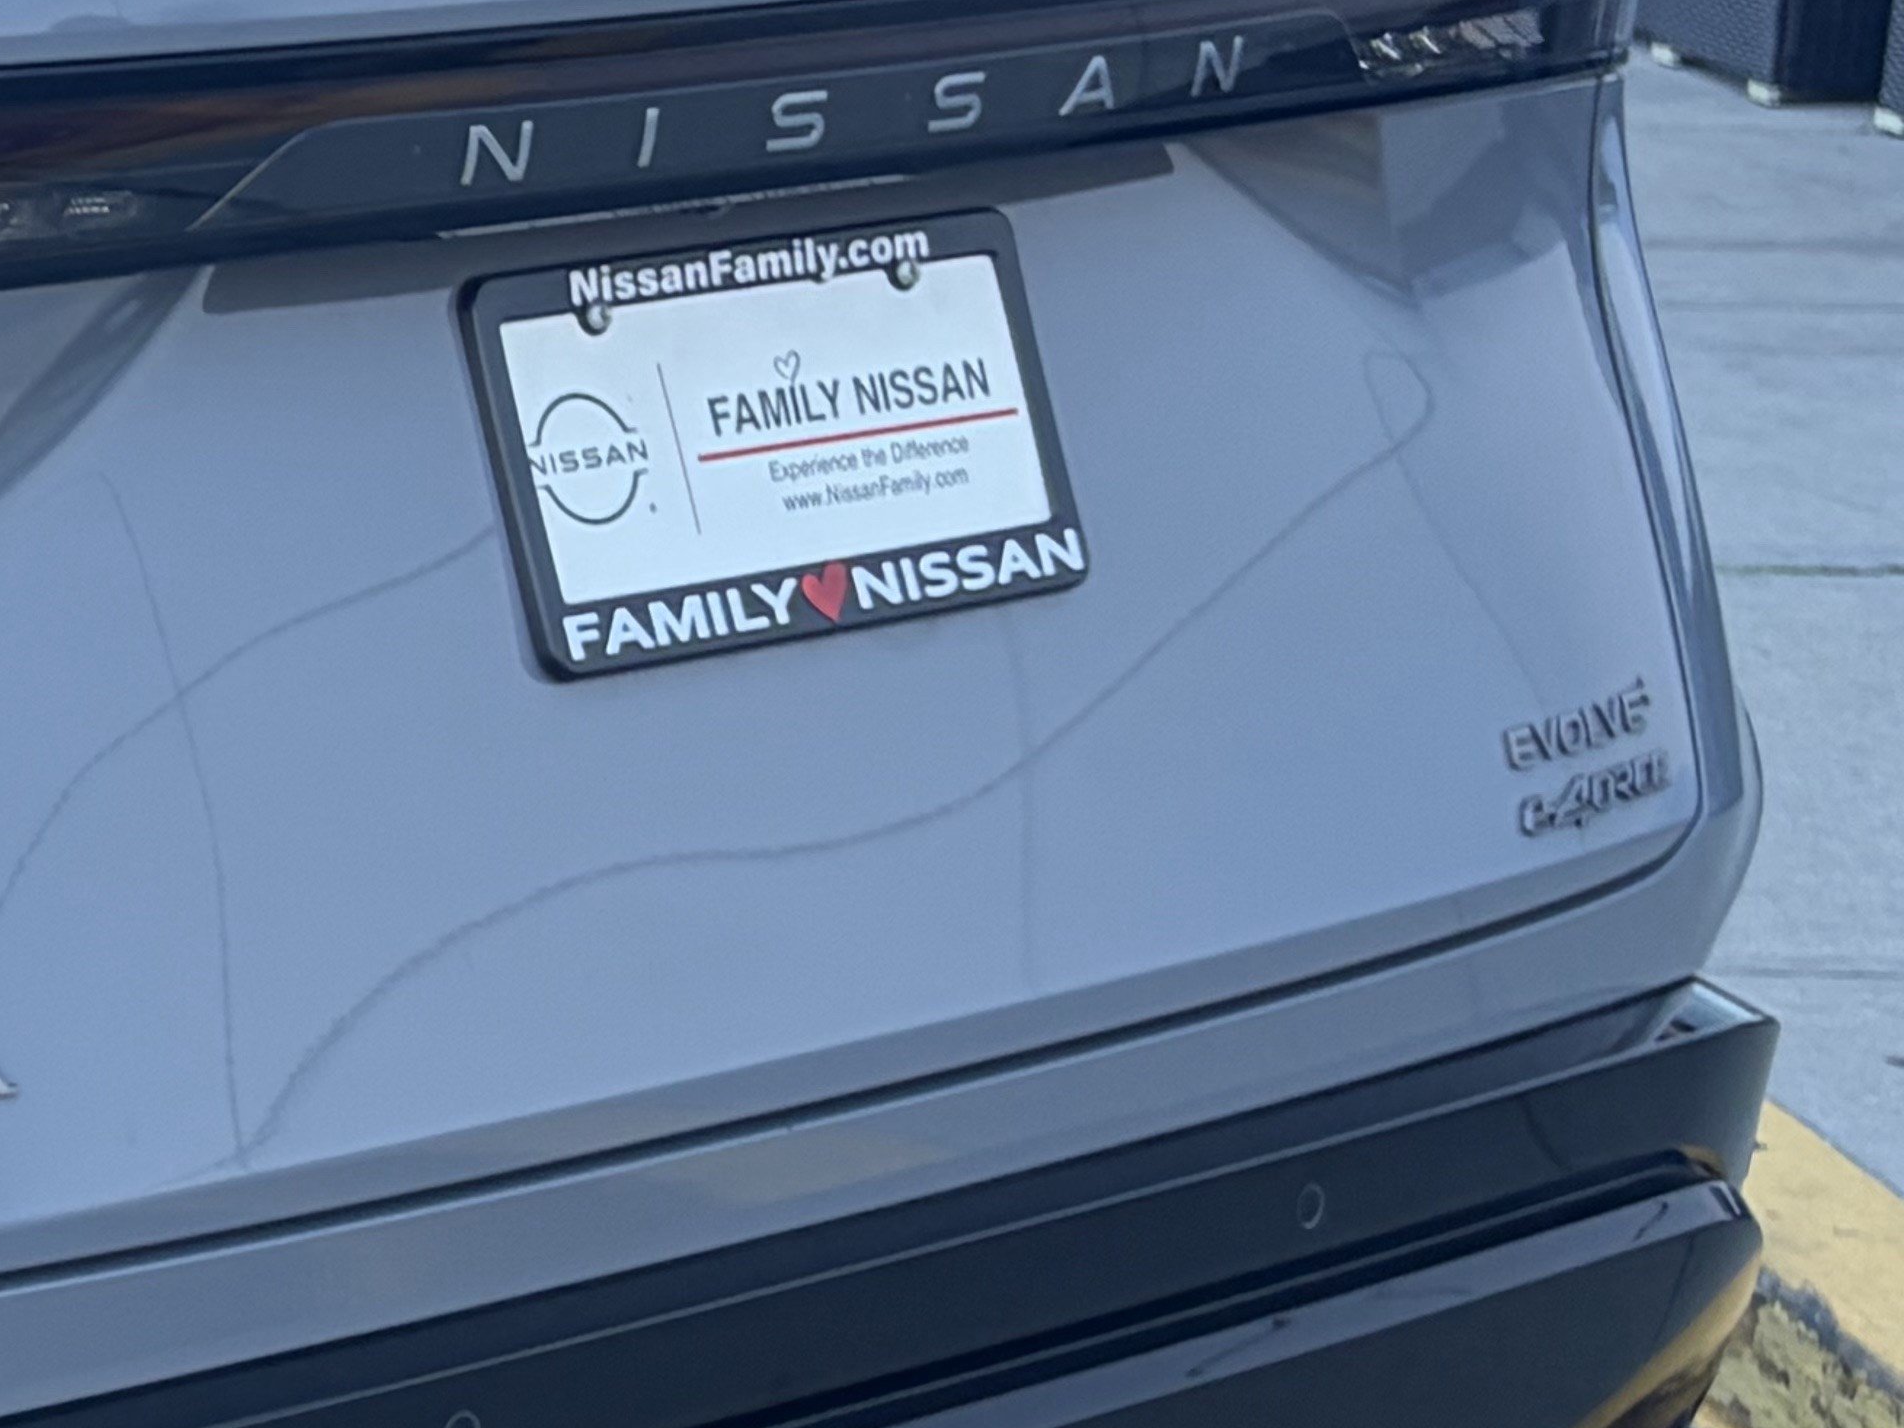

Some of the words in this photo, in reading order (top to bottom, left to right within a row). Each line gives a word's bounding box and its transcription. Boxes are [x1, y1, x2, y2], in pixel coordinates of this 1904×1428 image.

[460, 34, 1246, 186] NISSAN
[569, 230, 931, 307] NissanFamily.com
[707, 377, 842, 437] FAMILY
[852, 357, 991, 417] NISSAN
[528, 437, 649, 476] NISSAN
[767, 449, 859, 484] Experience
[861, 443, 888, 468] the
[890, 433, 971, 466] Difference
[782, 464, 971, 513] www.NissanFamily.com
[562, 576, 798, 663] FAMILY
[853, 528, 1085, 611] NISSAN
